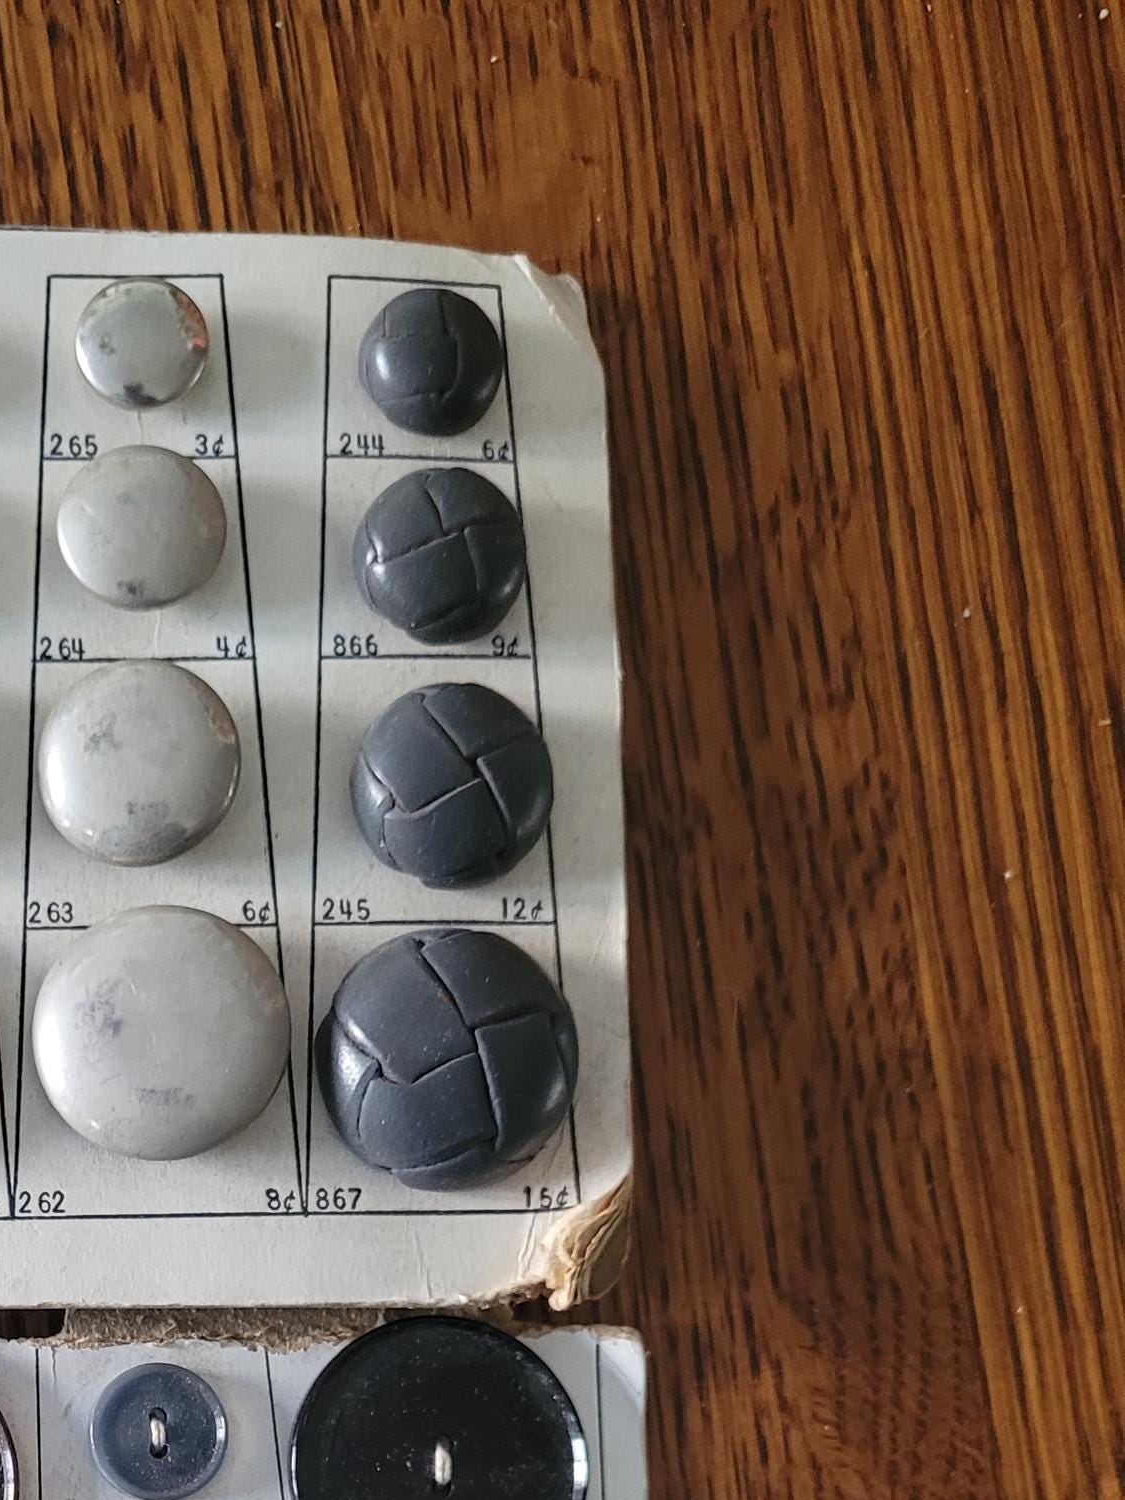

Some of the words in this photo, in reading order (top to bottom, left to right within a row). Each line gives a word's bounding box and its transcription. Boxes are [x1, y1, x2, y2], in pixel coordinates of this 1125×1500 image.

[50, 435, 97, 456] 265
[194, 434, 225, 456] 3¢
[339, 434, 384, 455] 244
[482, 441, 509, 462] 6¢
[40, 638, 85, 659] 264
[216, 637, 247, 658] 4¢
[333, 635, 378, 656] 866
[492, 636, 518, 657] 9¢
[29, 902, 73, 923] 263
[242, 900, 271, 923] 6¢
[323, 899, 370, 920] 245
[502, 898, 542, 921] 12¢
[18, 1191, 65, 1213] 262
[266, 1189, 295, 1212] 8¢
[316, 1188, 362, 1209] 867
[523, 1186, 568, 1210] 15¢
